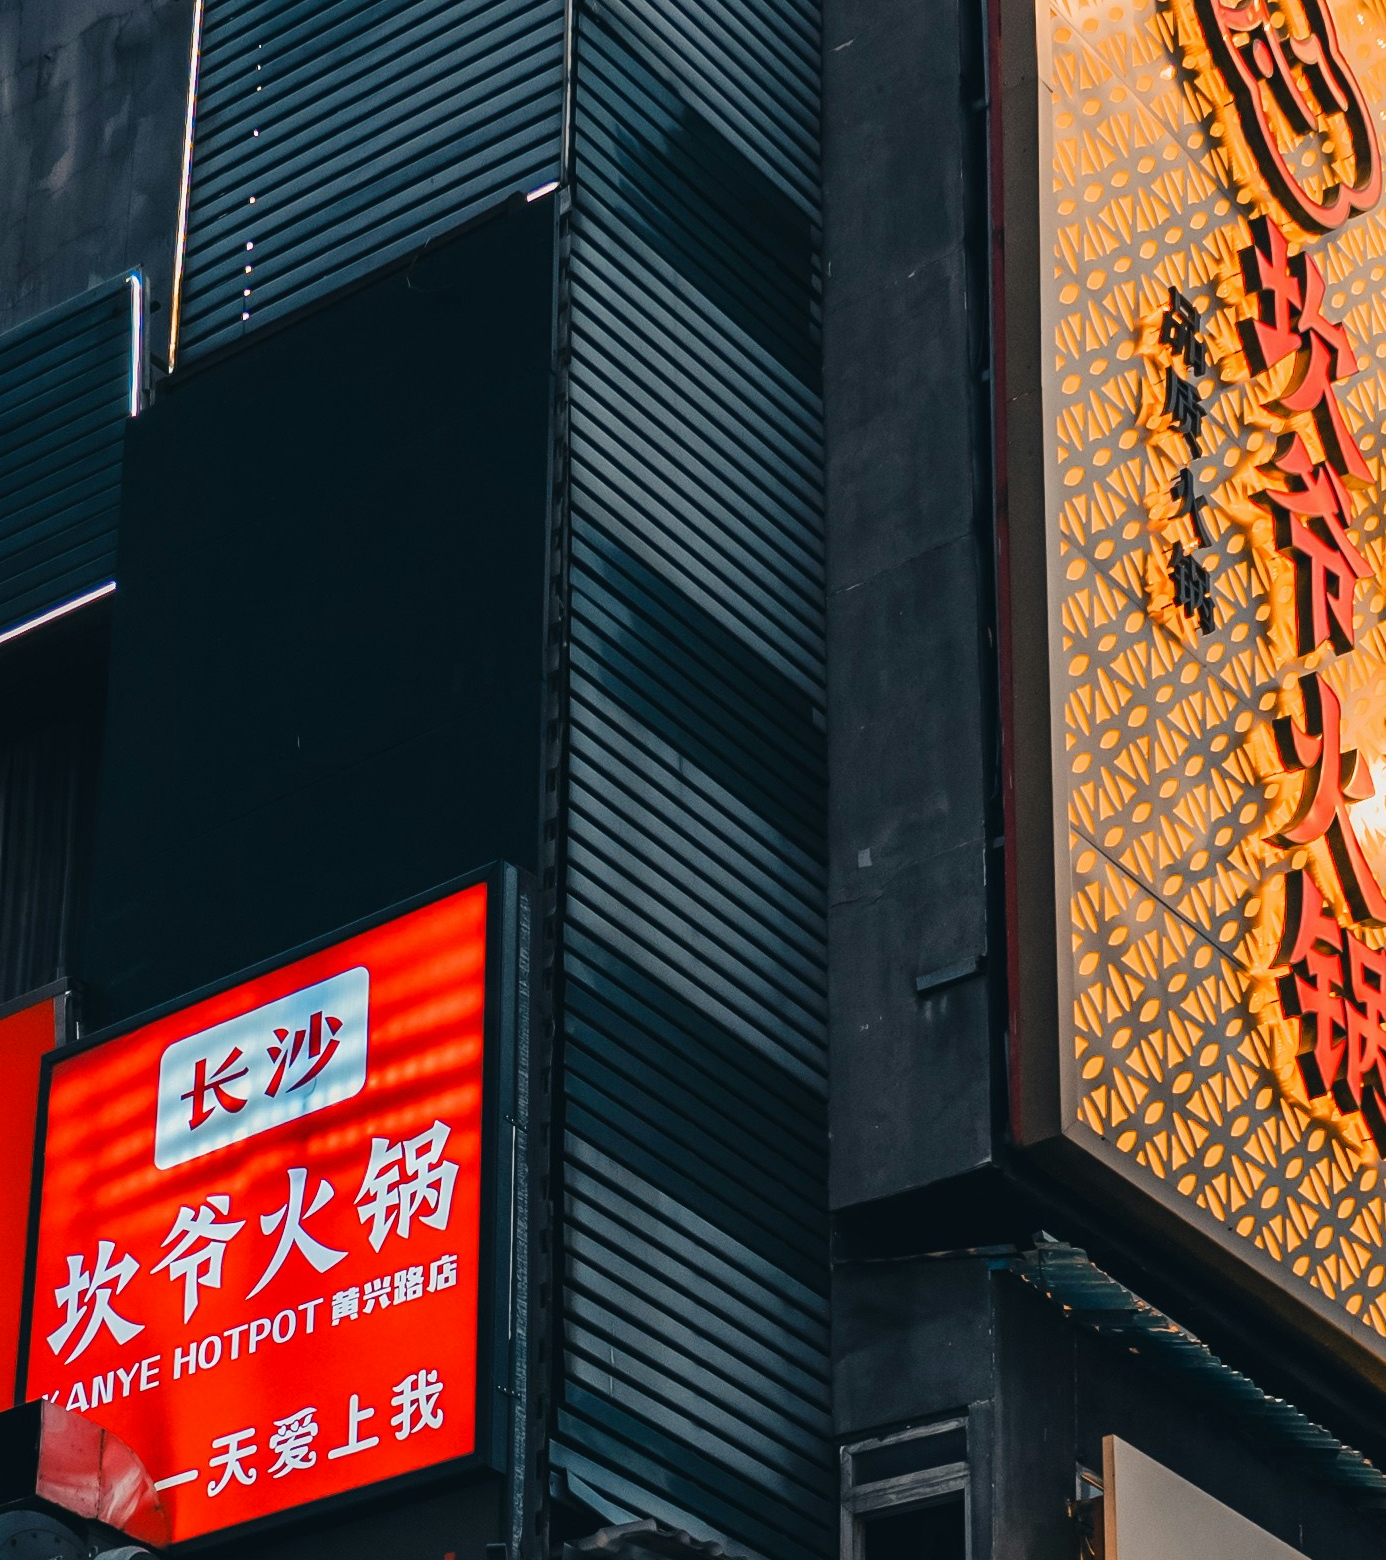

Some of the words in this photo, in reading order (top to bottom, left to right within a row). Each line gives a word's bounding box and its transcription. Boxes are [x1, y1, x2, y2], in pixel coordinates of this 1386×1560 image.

[180, 1011, 343, 1131] 长沙
[46, 1120, 460, 1364] 坎爷火锅
[332, 1255, 457, 1327] 黄兴路店
[173, 1299, 324, 1380] HOTPOT
